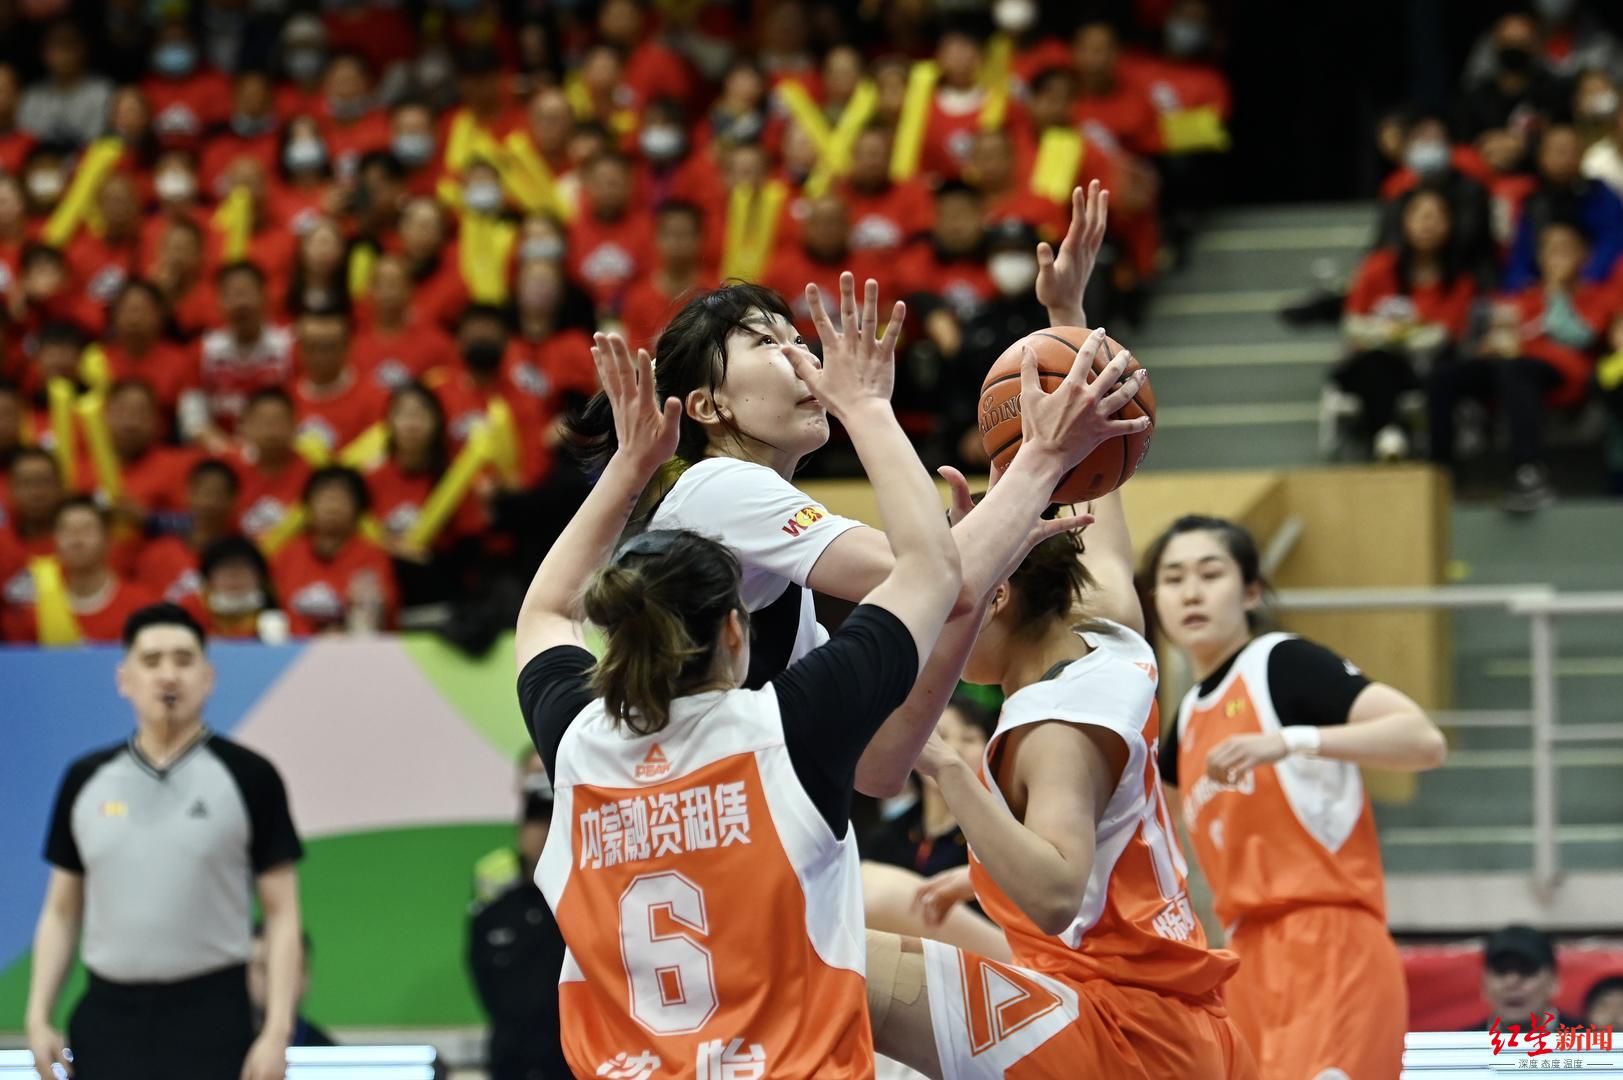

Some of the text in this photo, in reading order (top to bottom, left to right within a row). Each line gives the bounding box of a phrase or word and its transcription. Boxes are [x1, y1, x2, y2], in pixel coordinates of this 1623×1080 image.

[579, 780, 752, 871] 内蒙融资租赁
[618, 869, 719, 1037] 6
